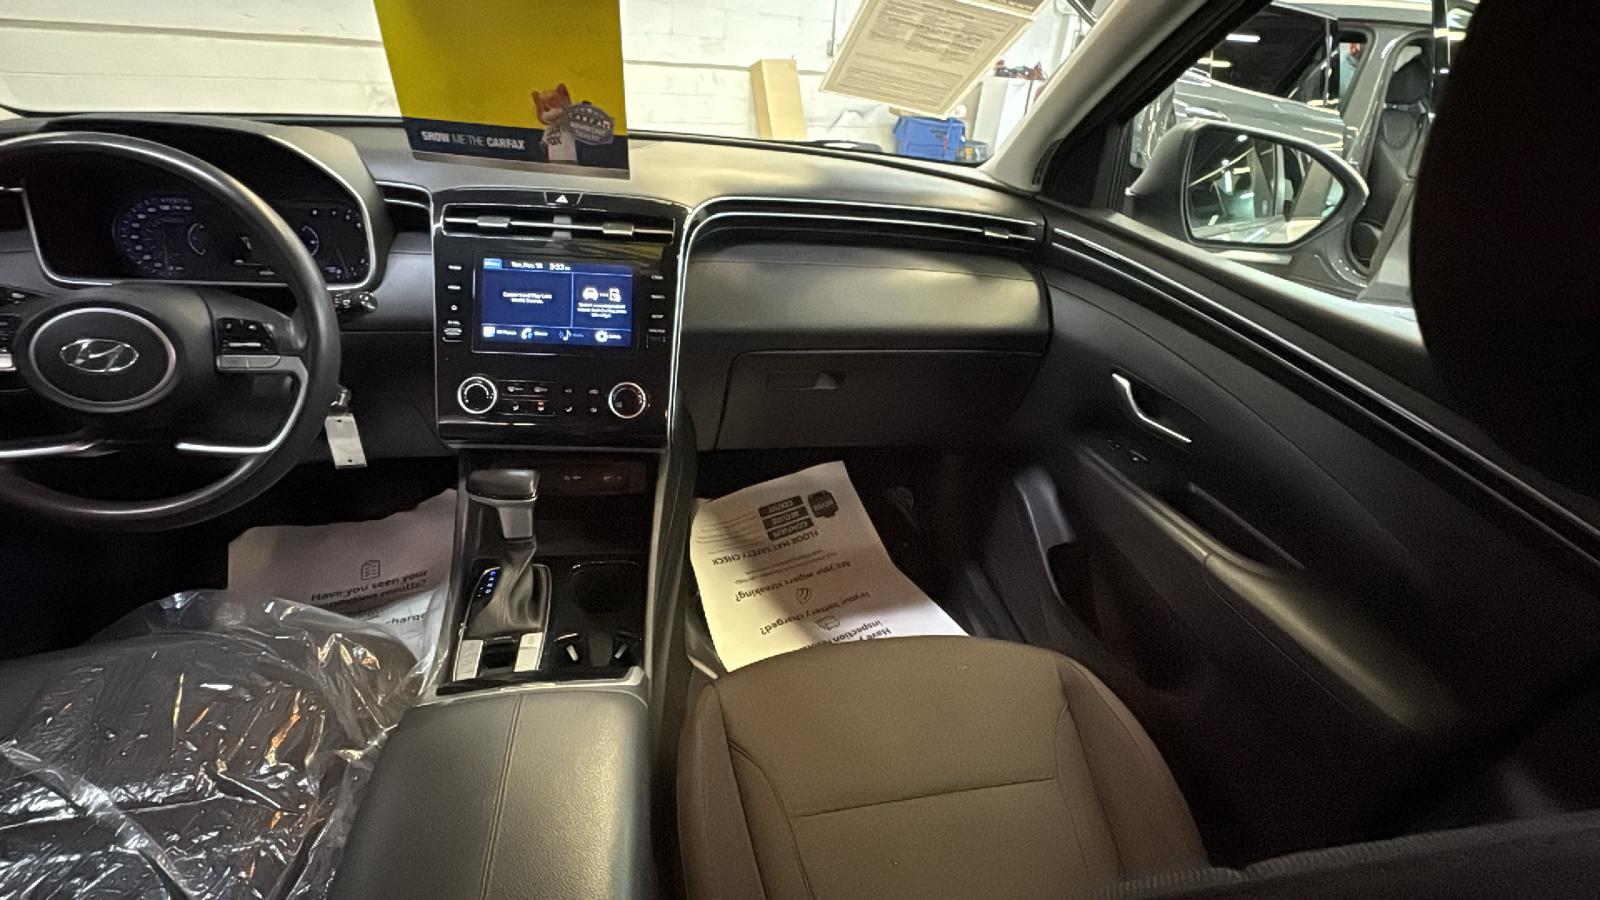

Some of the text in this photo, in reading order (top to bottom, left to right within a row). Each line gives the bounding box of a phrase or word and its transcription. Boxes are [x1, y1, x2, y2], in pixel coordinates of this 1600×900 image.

[420, 131, 525, 150] SHOW ME THE CARFAX
[791, 530, 819, 546] FLOOR
[711, 553, 741, 565] CHECK
[742, 546, 772, 559] SAFETY
[816, 564, 834, 576] your
[311, 570, 428, 602] Have you seen your
[785, 571, 814, 586] wipers
[380, 579, 427, 597] results?
[735, 581, 783, 602] streaking?
[841, 594, 861, 606] your
[806, 602, 841, 617] battery
[760, 613, 804, 635] charged?
[834, 620, 884, 643] inspection
[869, 627, 892, 641] Have
